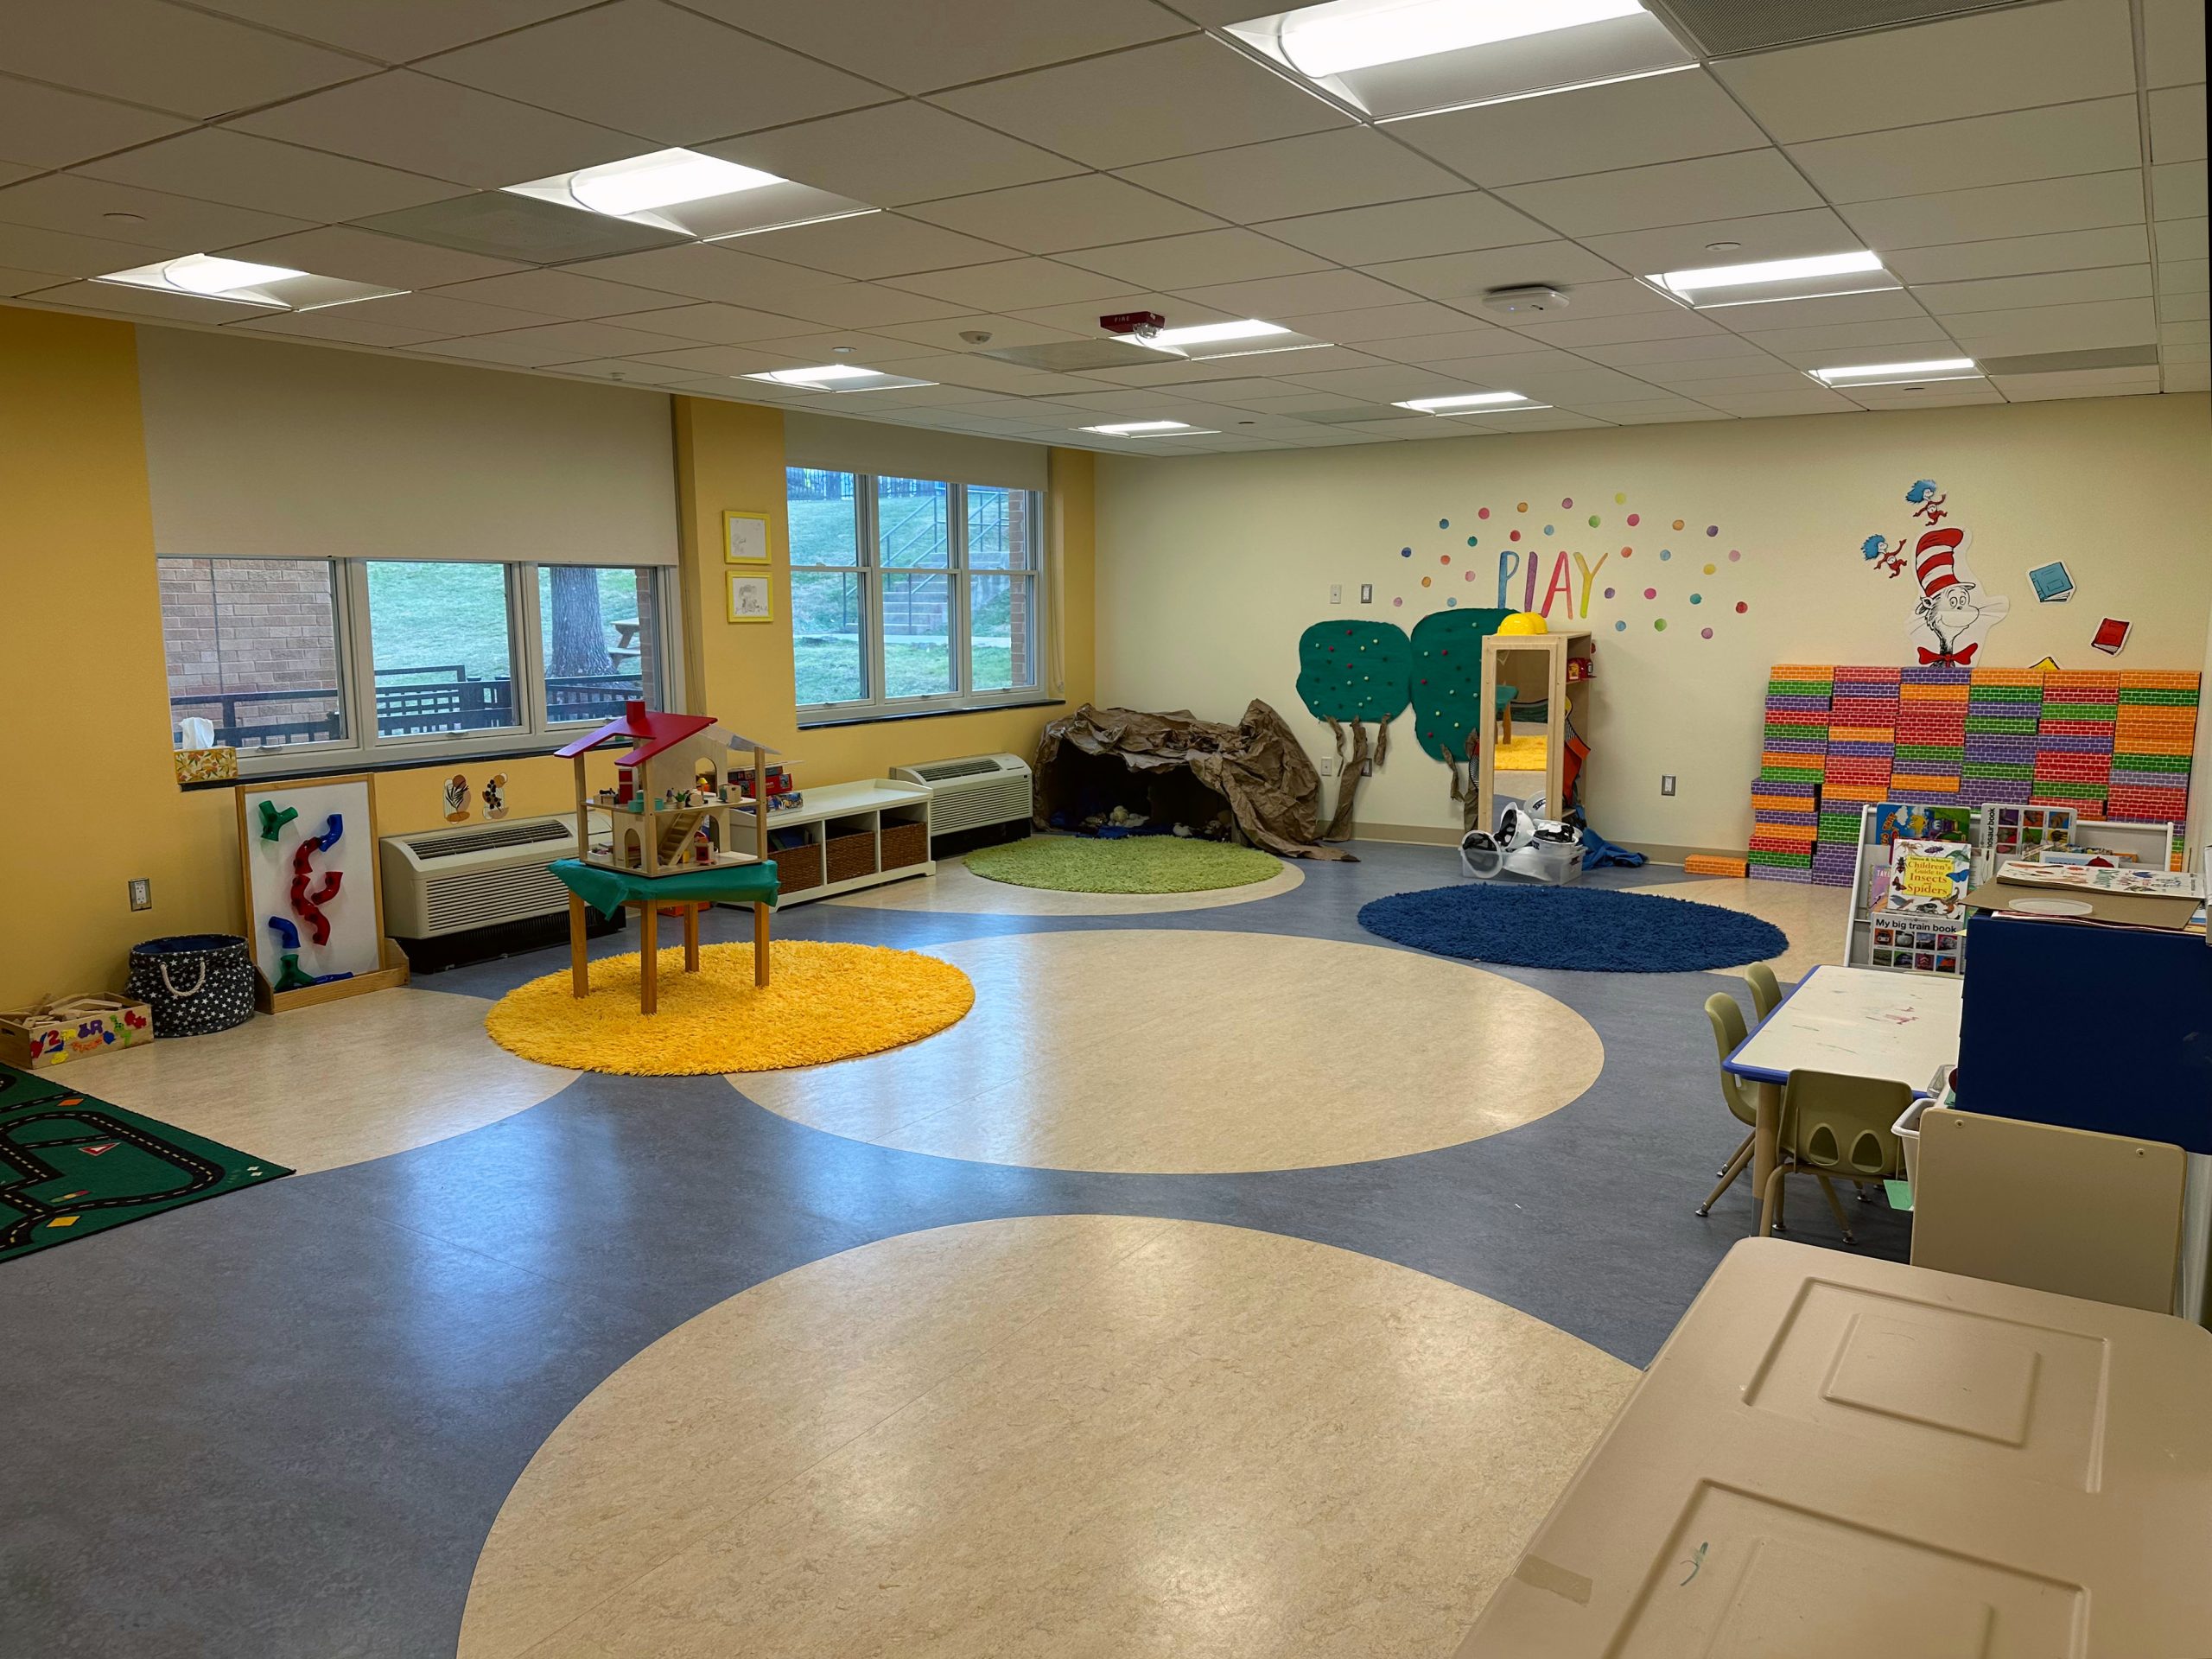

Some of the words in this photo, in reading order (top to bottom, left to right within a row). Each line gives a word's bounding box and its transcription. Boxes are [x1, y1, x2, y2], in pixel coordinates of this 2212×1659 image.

[1497, 550, 1608, 620] PLAY
[1908, 861, 1952, 870] Children's
[1910, 873, 1948, 883] Insects
[1907, 883, 1948, 895] Spiders
[1876, 918, 1890, 928] My
[1892, 920, 1906, 930] big
[1909, 922, 1929, 931] train
[1933, 924, 1957, 933] book
